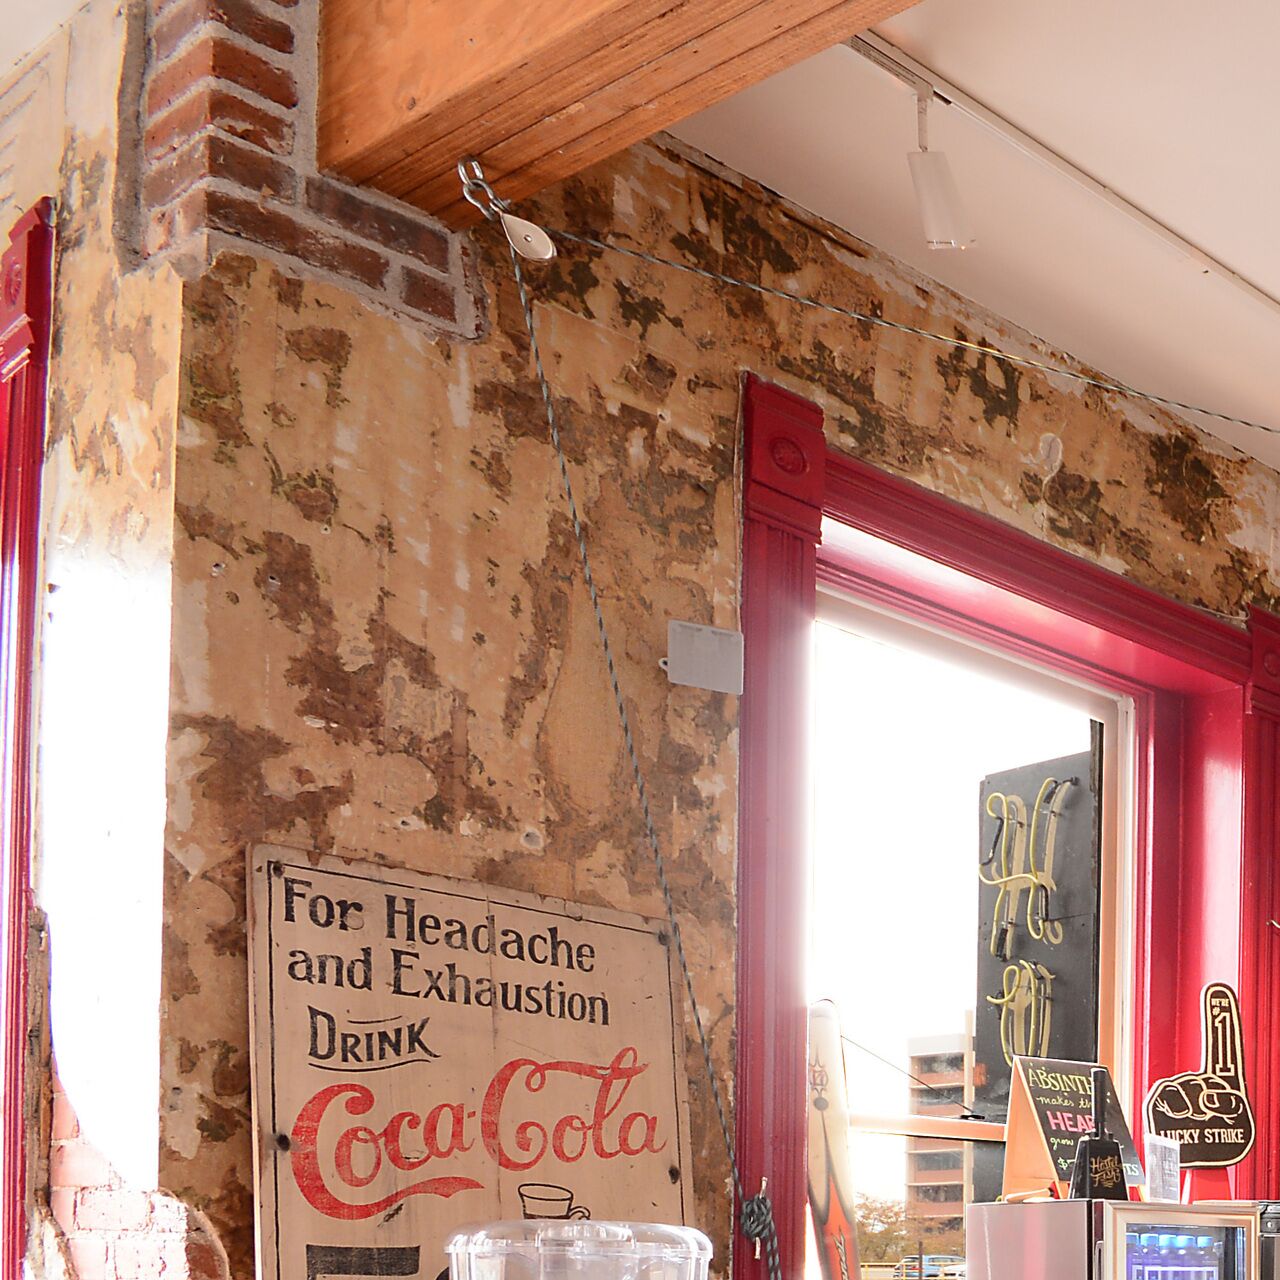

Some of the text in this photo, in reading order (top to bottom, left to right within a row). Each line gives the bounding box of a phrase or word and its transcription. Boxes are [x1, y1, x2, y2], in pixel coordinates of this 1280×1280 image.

[282, 875, 597, 975] For Headache
[287, 947, 611, 1027] and Exhaustion
[306, 1004, 441, 1064] DRINK
[1028, 1067, 1093, 1096] ABSINTH
[290, 1046, 667, 1221] Coca-Cola
[1204, 1128, 1245, 1144] STRIKE
